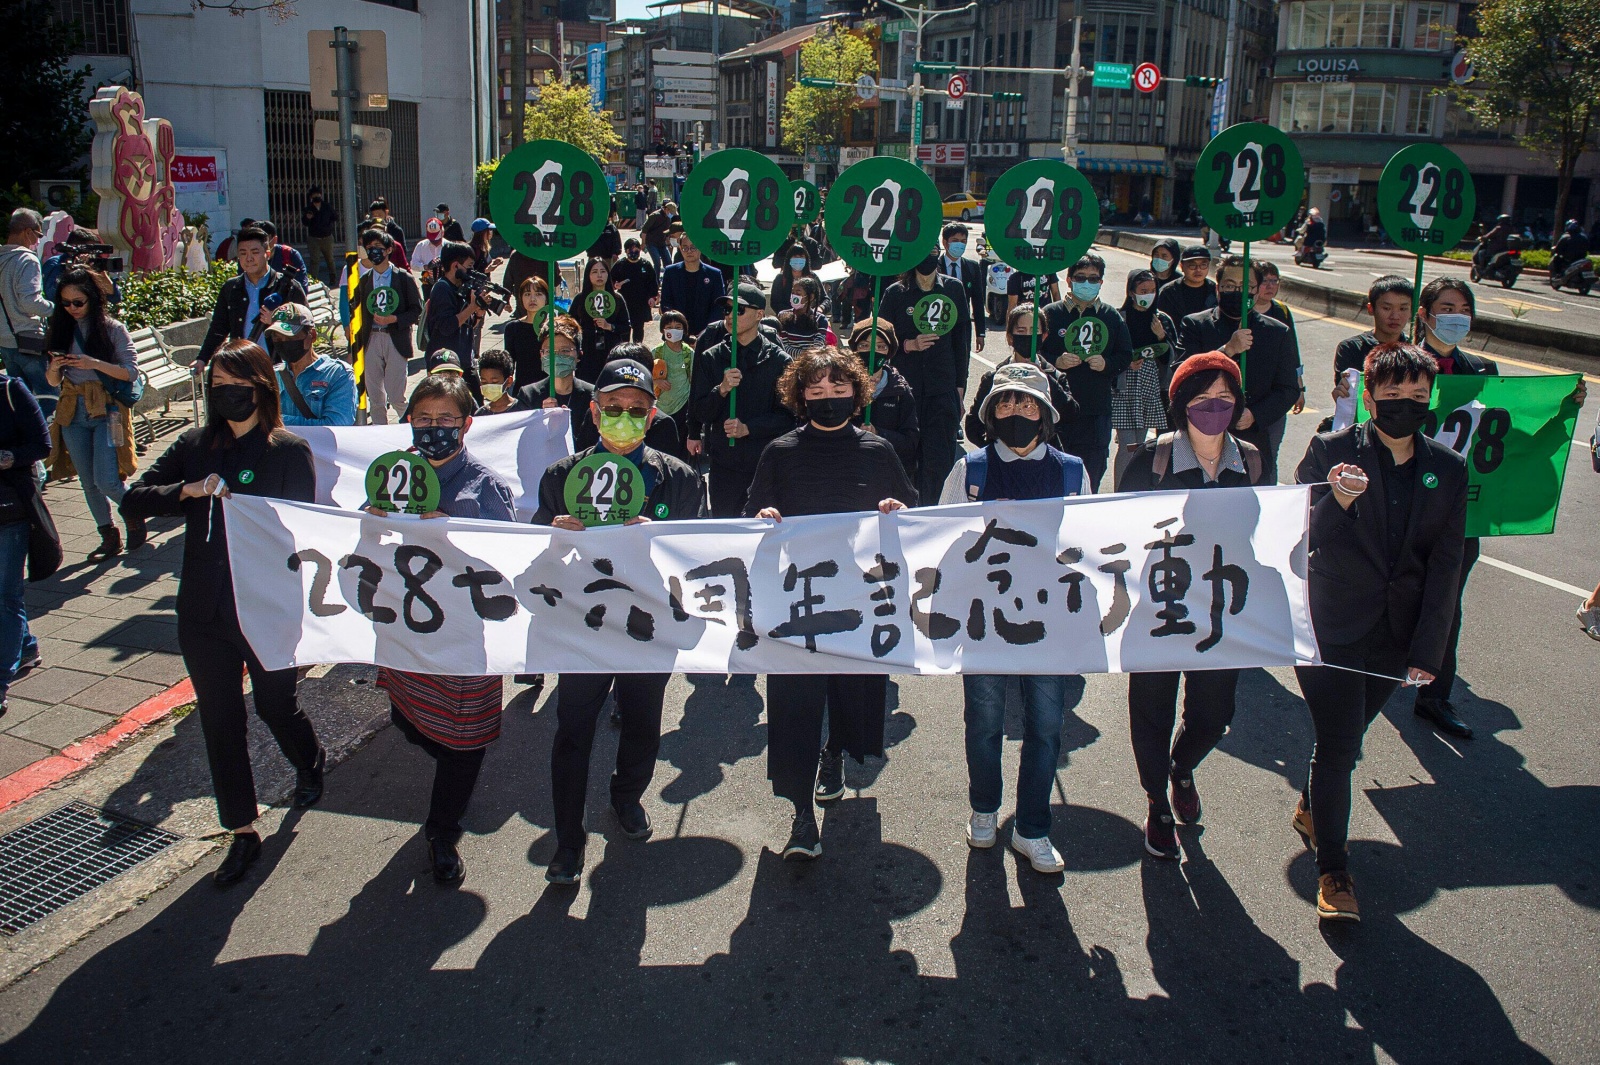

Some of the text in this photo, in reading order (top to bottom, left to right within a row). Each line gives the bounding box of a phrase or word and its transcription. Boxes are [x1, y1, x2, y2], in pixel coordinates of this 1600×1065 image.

[1297, 58, 1360, 72] LOUISA
[1306, 74, 1348, 83] COFFEE
[1212, 143, 1286, 204] 228
[513, 170, 594, 227] 228
[1397, 163, 1464, 220] 228
[702, 176, 779, 231] 228
[841, 184, 922, 243] 228
[1004, 187, 1083, 240] 228
[1225, 210, 1274, 229] 和平日
[523, 231, 577, 248] 和平日
[1401, 227, 1444, 245] 和平日
[711, 239, 761, 256] 和平日
[852, 241, 903, 261] 和平日
[1014, 244, 1065, 261] 和平日
[371, 290, 394, 308] 228
[588, 294, 610, 311] 228
[919, 301, 952, 323] 228
[918, 322, 949, 331] 七十六年
[1071, 323, 1102, 346] 228
[614, 366, 646, 381] YMCA
[374, 464, 428, 502] 228
[576, 465, 633, 506] 228
[575, 506, 631, 521] 七十六年
